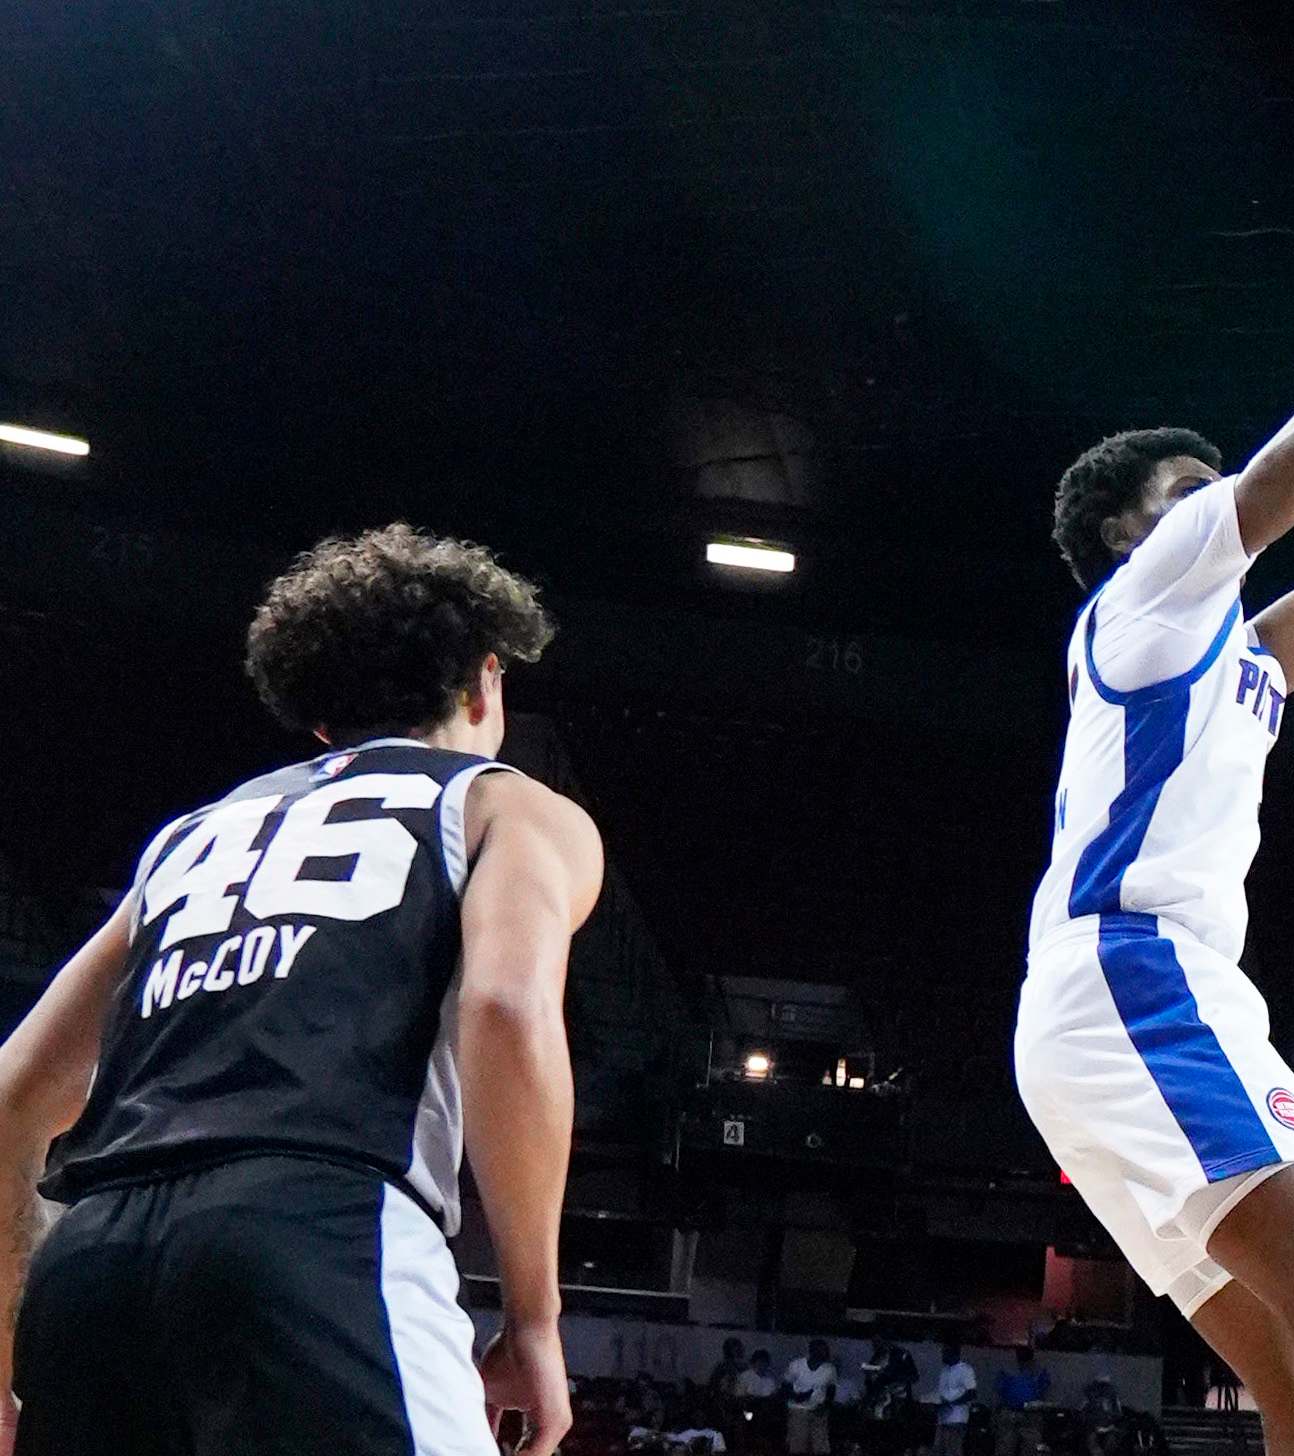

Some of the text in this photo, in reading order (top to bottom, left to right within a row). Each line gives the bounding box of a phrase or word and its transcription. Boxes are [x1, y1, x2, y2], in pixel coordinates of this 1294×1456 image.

[804, 634, 863, 674] 216
[143, 773, 442, 951] 46
[141, 925, 316, 1019] McCOY
